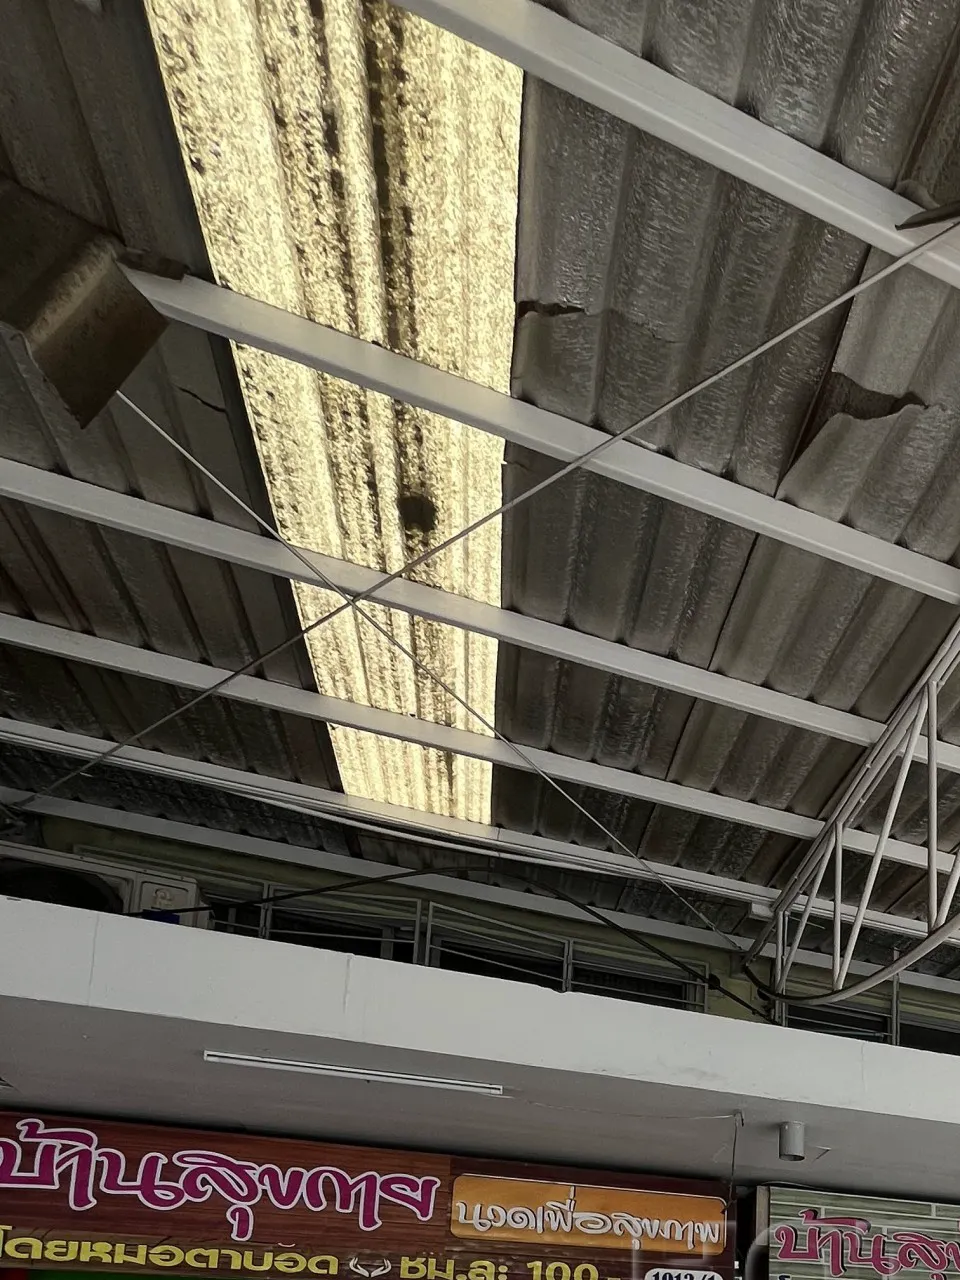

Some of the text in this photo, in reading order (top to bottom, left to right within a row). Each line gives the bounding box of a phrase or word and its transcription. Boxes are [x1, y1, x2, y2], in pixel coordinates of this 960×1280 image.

[0, 1118, 441, 1241] บ้านสุขกาย
[456, 1185, 721, 1250] นวดเพื่อสุขภาพ
